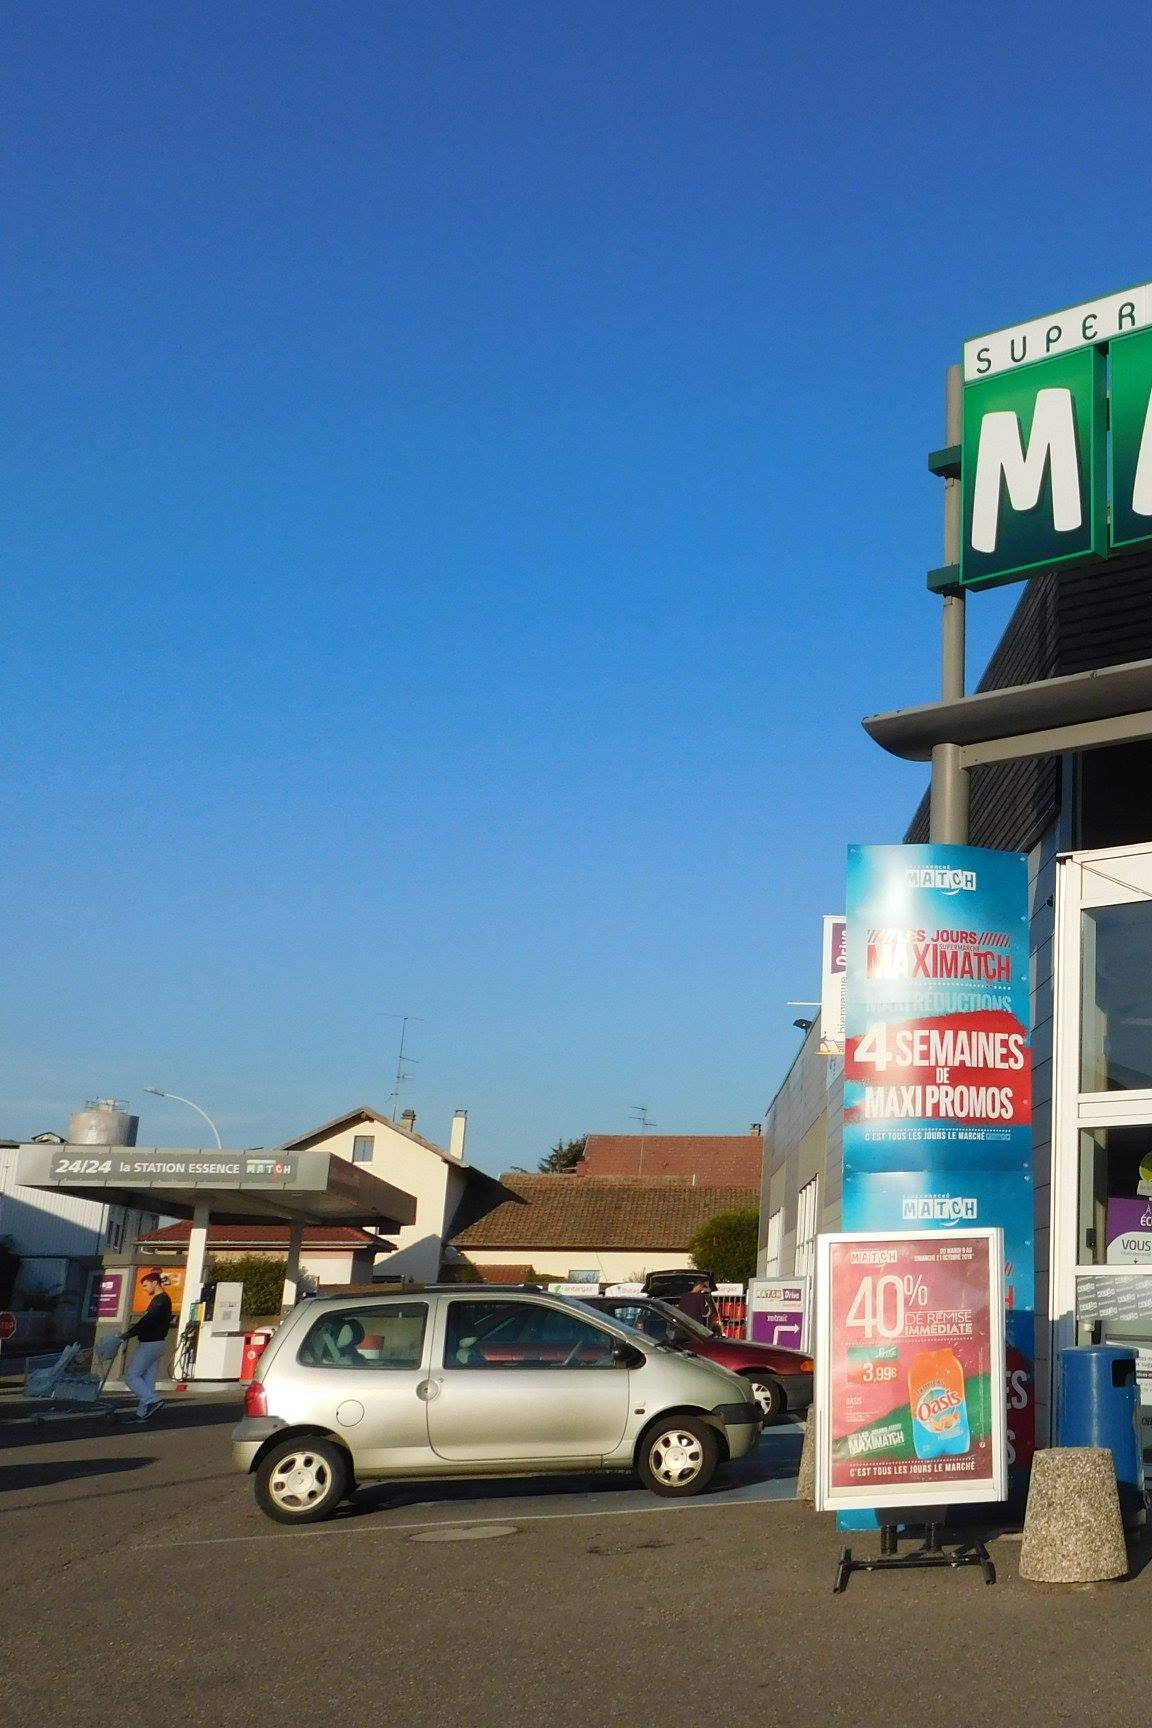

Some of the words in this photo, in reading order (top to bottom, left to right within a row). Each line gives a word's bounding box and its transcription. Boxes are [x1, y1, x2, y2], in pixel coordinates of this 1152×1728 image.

[931, 930, 977, 945] JOURS
[853, 1023, 894, 1072] 4
[895, 1029, 1025, 1070] SEMAINES
[935, 1067, 950, 1084] DE
[864, 1086, 922, 1119] MAXI
[925, 1085, 1014, 1120] PROMOS
[923, 1131, 946, 1140] JOURS
[948, 1131, 957, 1140] LE
[959, 1130, 986, 1141] MARCHÉ
[55, 1159, 112, 1174] 24/24
[120, 1162, 131, 1172] la
[134, 1162, 185, 1173] STATION
[188, 1163, 240, 1174] ESSENCE
[246, 1162, 291, 1177] MATCH
[904, 1199, 976, 1218] MATCH
[1121, 1239, 1151, 1251] VOUS
[905, 1312, 925, 1325] DE
[927, 1310, 972, 1324] REMISE
[917, 1389, 961, 1422] Oasis
[849, 1467, 871, 1477] C'EST
[873, 1466, 892, 1476] TOUS
[893, 1466, 908, 1475] LES
[909, 1464, 932, 1474] JOURS
[934, 1463, 943, 1472] LE
[944, 1461, 975, 1471] MARCHÉ
